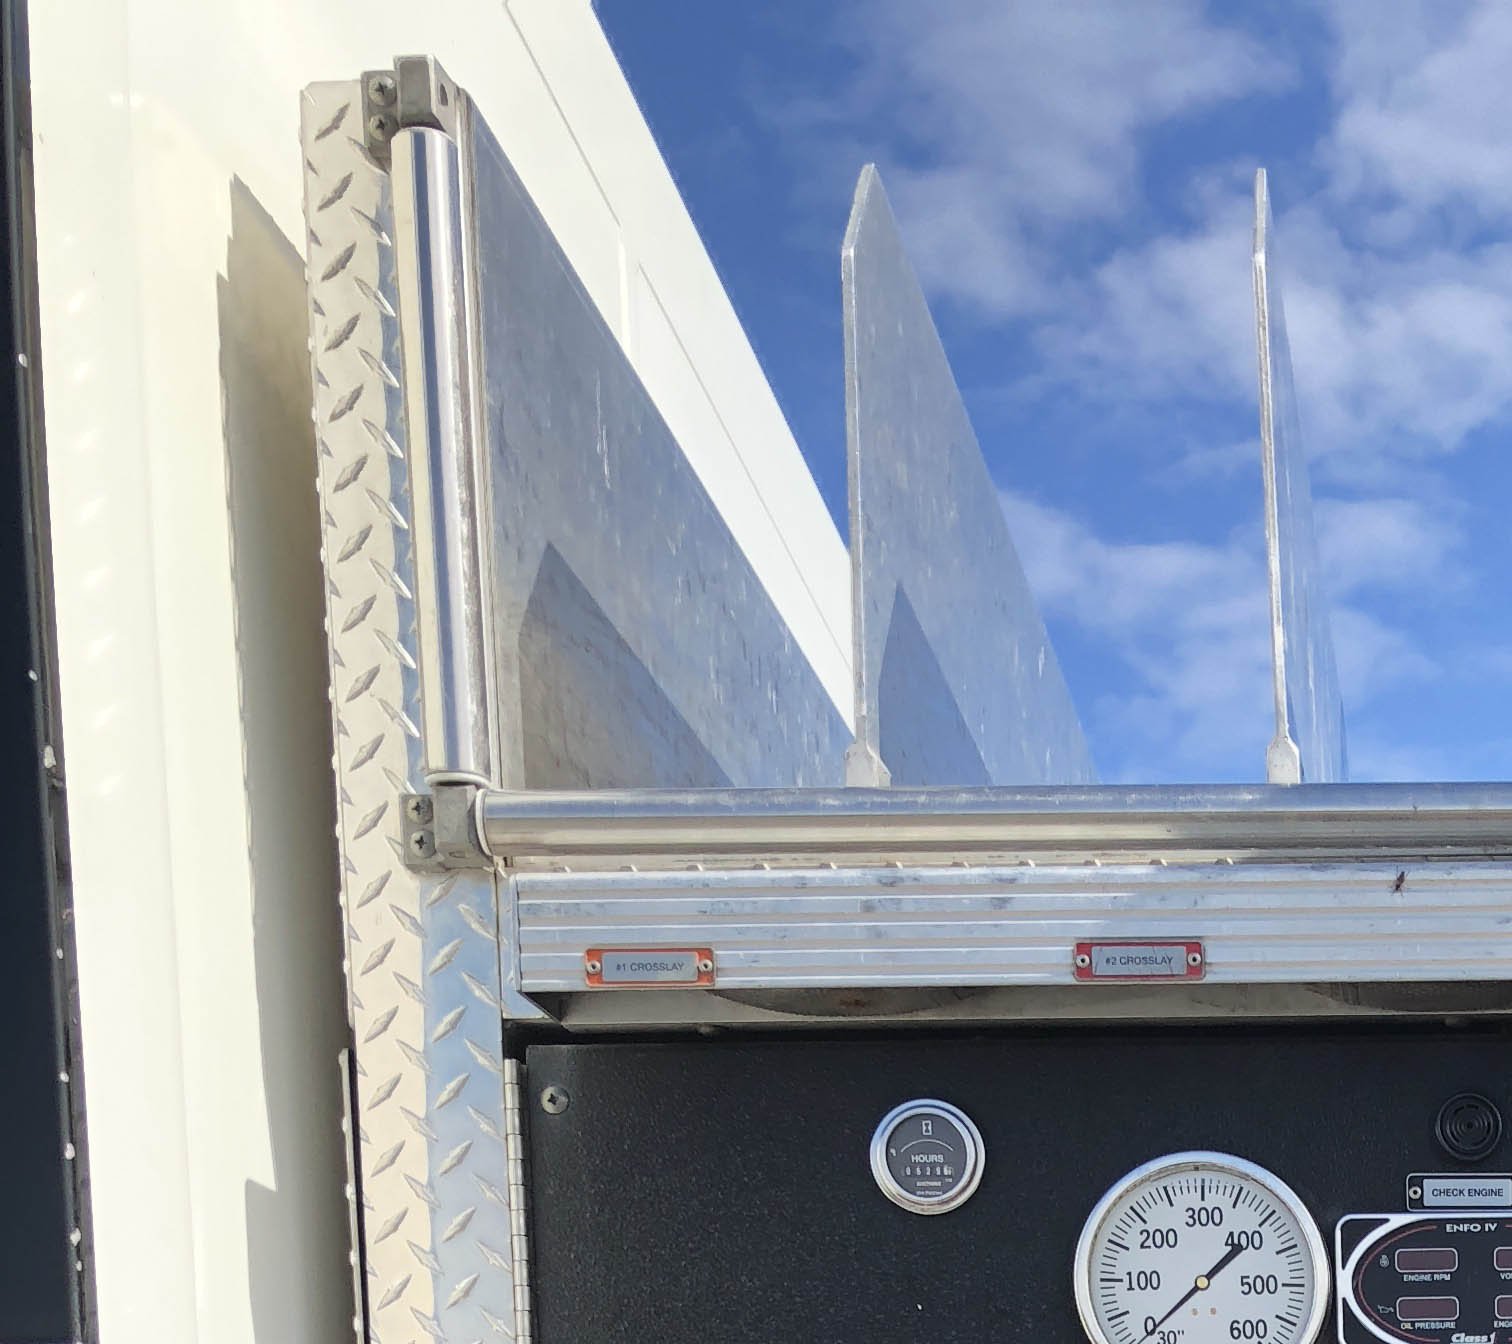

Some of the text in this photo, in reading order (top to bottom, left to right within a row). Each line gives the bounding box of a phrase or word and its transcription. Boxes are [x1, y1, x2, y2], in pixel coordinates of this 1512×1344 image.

[616, 961, 685, 972] #1 CROSSLAY
[1106, 955, 1174, 966] #2 CROSSLAY
[912, 1155, 944, 1163] HOURS
[1432, 1188, 1504, 1197] CHECK ENGINE
[1185, 1207, 1223, 1227] 300
[1446, 1224, 1498, 1233] ENFO IV
[1139, 1229, 1178, 1249] 200
[1225, 1231, 1263, 1250] 400
[1126, 1271, 1160, 1291] 100
[1240, 1275, 1278, 1295] 500
[1230, 1319, 1268, 1340] 600
